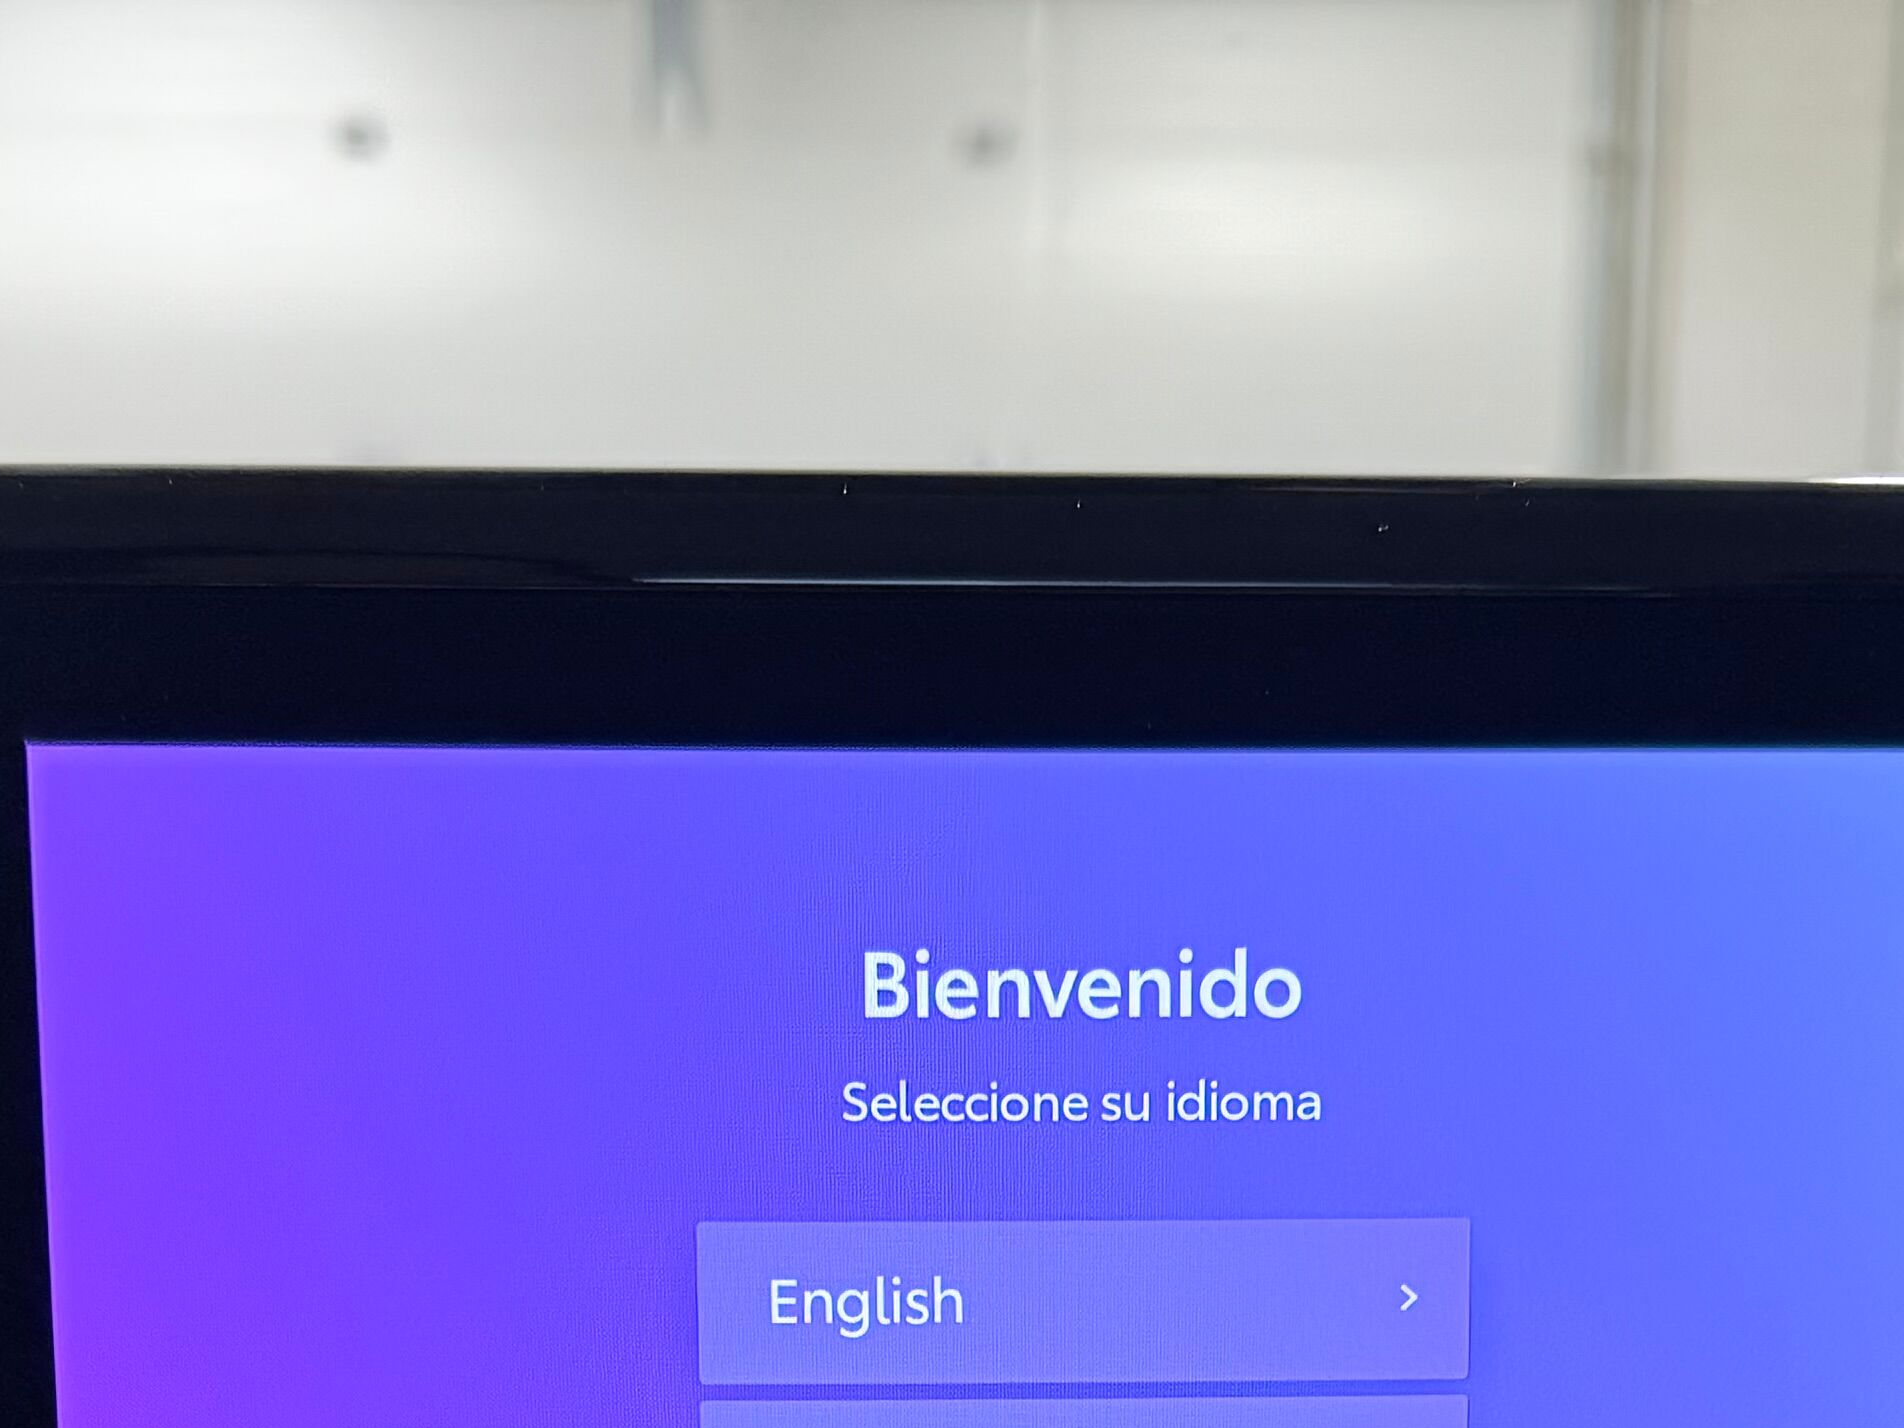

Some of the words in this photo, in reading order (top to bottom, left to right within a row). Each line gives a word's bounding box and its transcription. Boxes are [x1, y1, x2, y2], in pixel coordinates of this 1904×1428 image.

[862, 946, 1303, 1020] Bienvenido
[842, 1080, 1089, 1123] Seleccione
[1100, 1089, 1151, 1122] su
[1166, 1078, 1323, 1122] idioma
[768, 1276, 965, 1338] English
